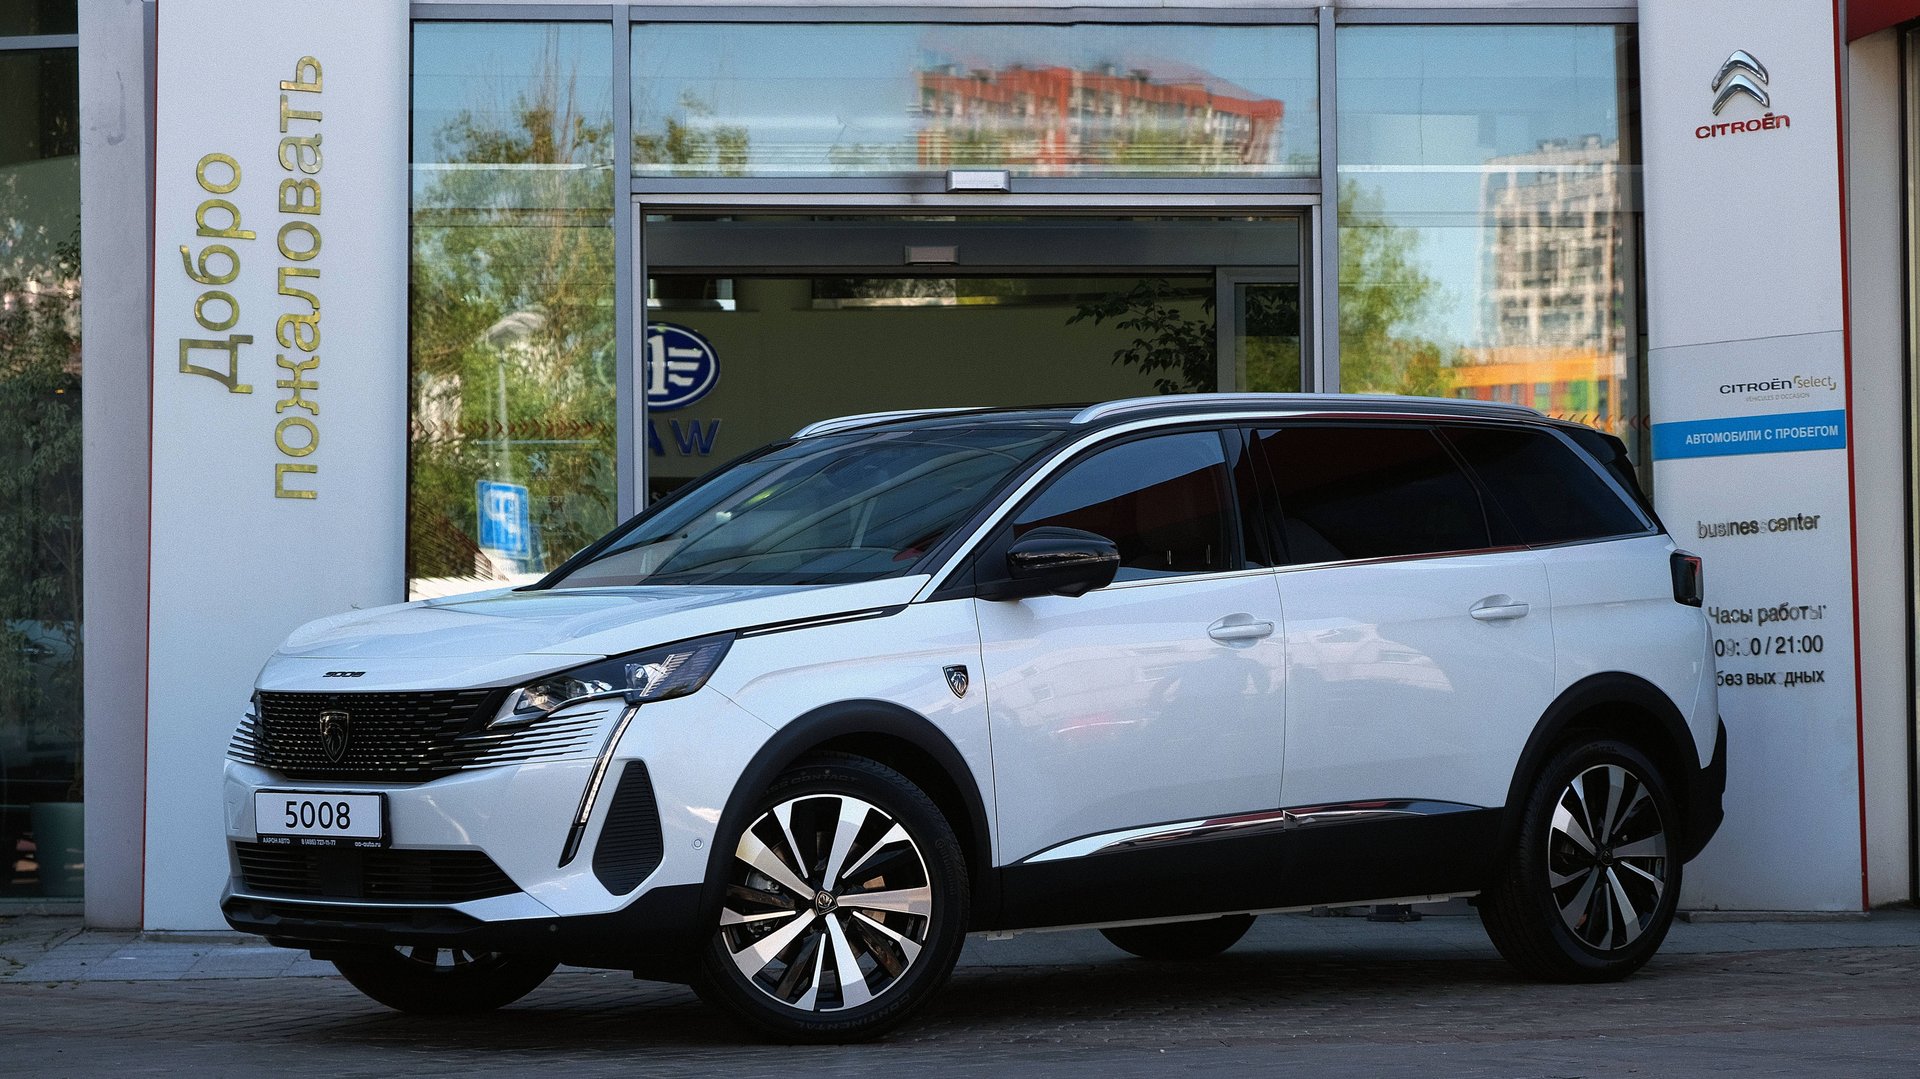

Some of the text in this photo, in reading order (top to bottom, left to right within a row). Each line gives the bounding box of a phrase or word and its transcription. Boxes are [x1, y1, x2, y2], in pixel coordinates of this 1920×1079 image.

[179, 152, 256, 394] Добро
[275, 55, 323, 500] пожаловать
[1685, 425, 1839, 445] АВТОМОБИЛИ С ПРОБЕГОМ
[1768, 513, 1821, 533] center
[1708, 605, 1753, 624] Часы
[1775, 634, 1824, 655] 21:00
[1717, 670, 1743, 687] без
[285, 801, 351, 830] 5008
